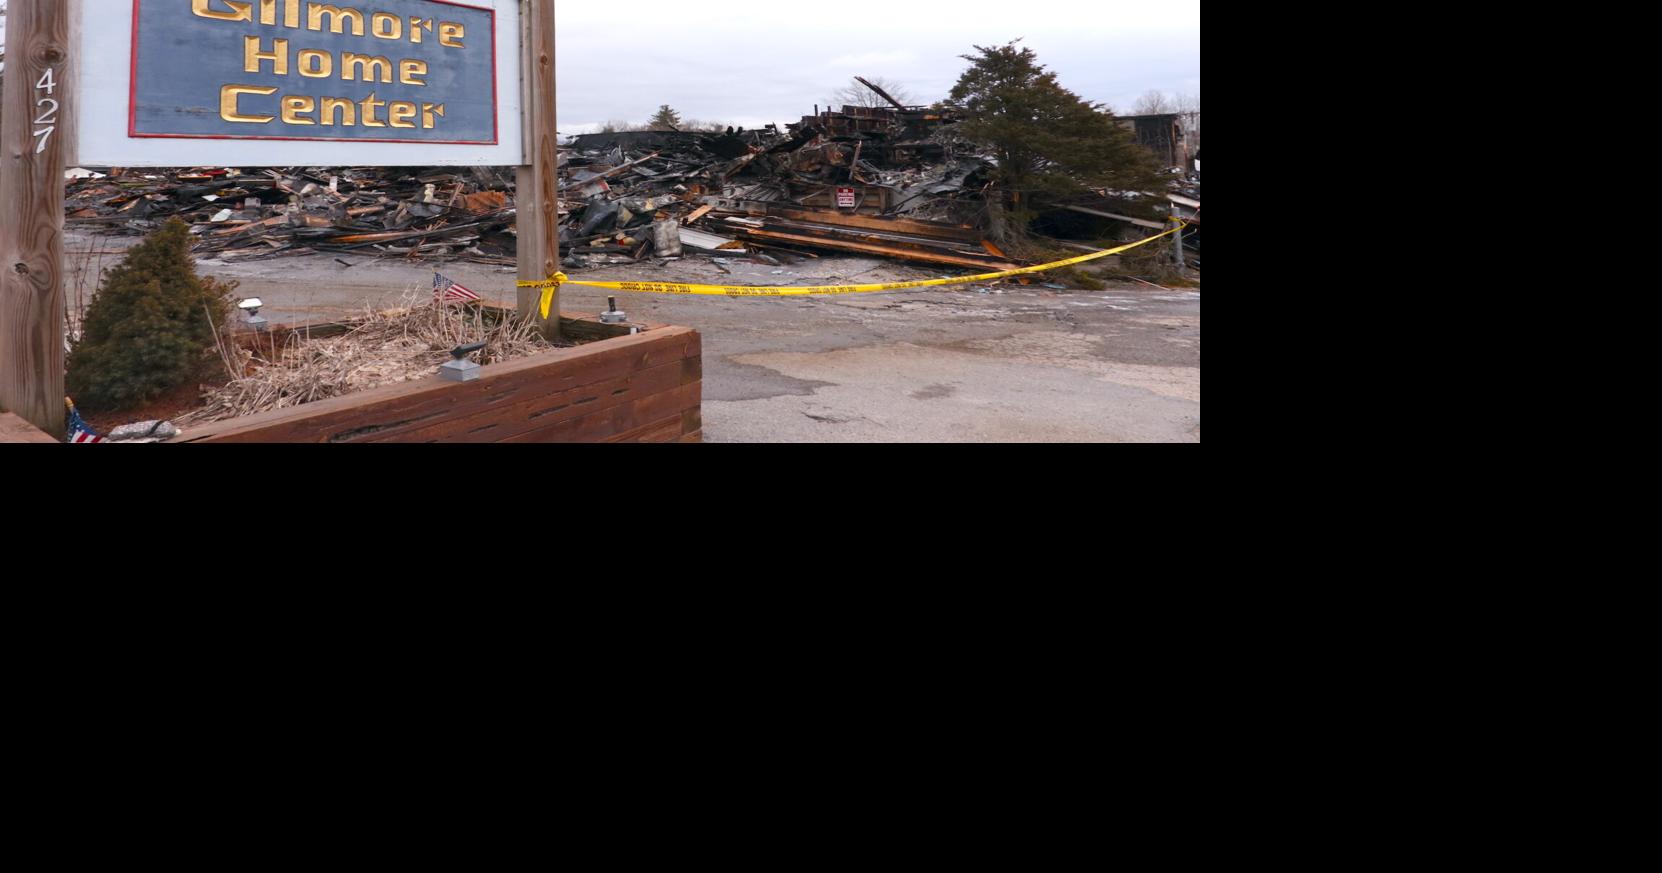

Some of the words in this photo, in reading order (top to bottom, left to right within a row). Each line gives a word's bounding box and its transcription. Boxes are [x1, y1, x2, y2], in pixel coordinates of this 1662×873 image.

[243, 35, 428, 86] Home
[33, 68, 59, 154] 427
[219, 83, 445, 129] Center
